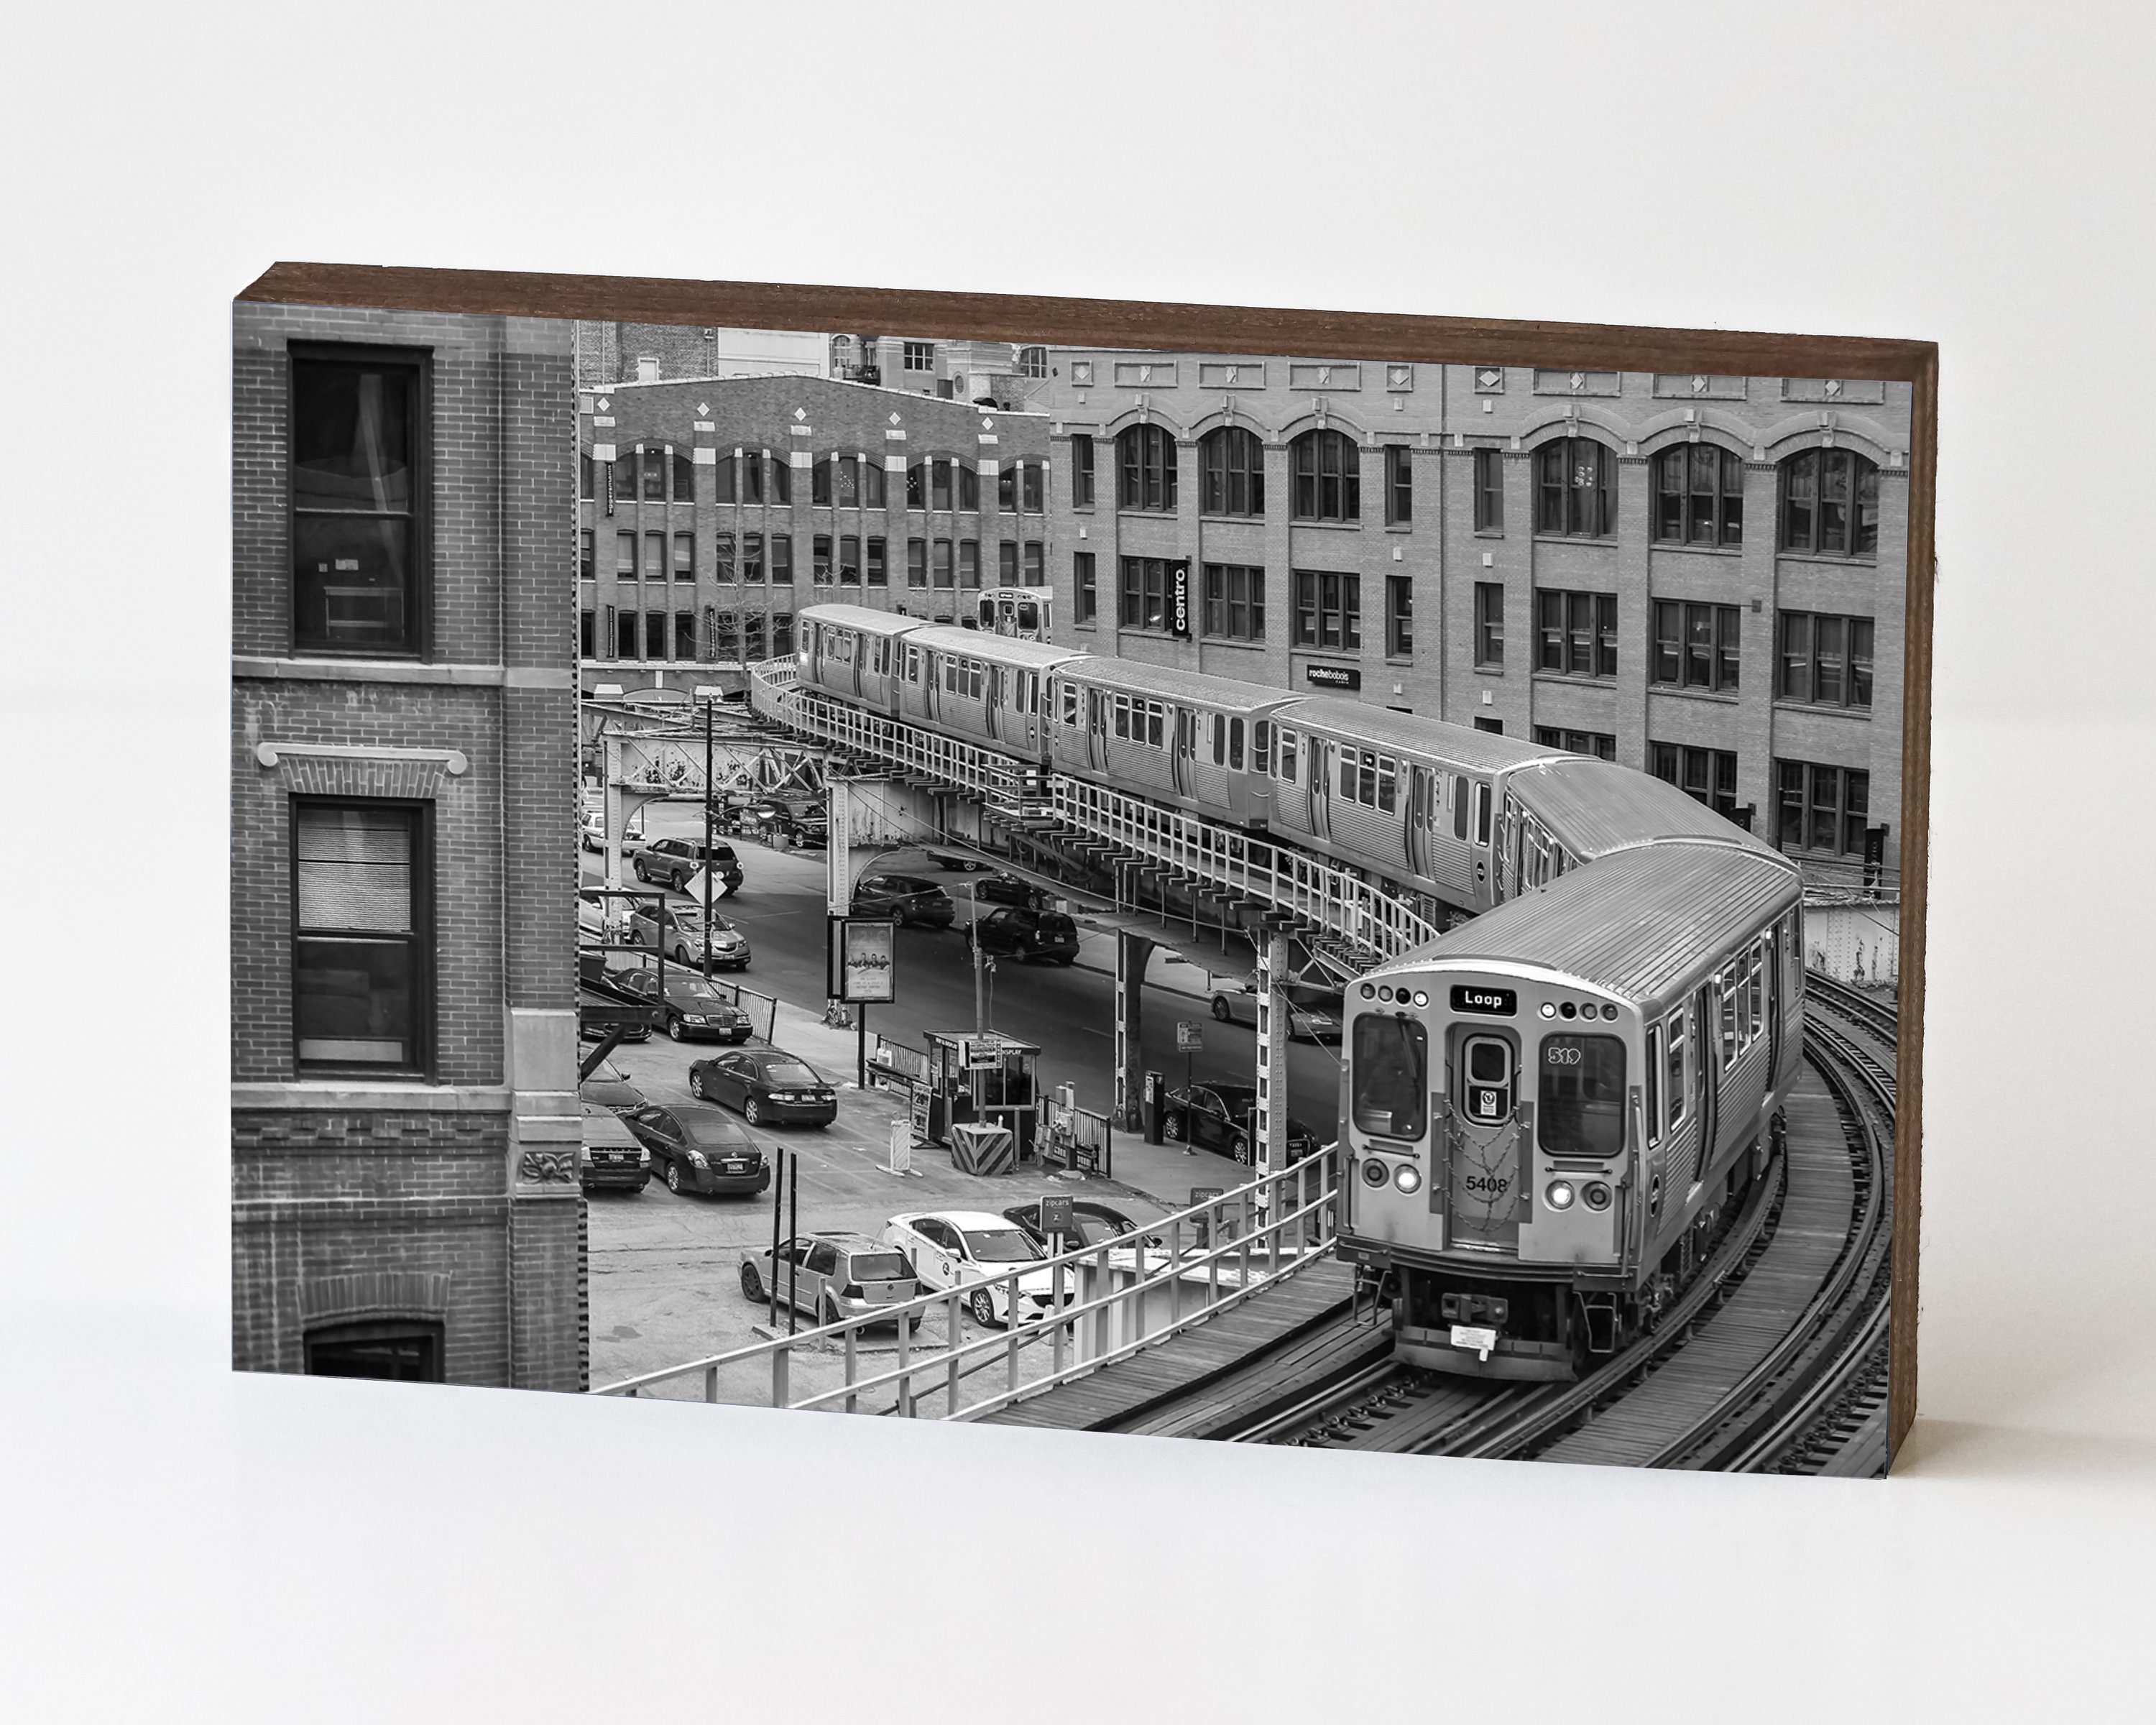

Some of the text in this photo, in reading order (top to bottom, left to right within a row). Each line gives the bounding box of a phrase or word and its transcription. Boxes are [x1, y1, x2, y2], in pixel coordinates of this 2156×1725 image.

[1175, 568, 1186, 630] centro
[1465, 990, 1502, 1008] Loop
[1548, 1047, 1580, 1065] 519
[1465, 1175, 1508, 1193] 5408
